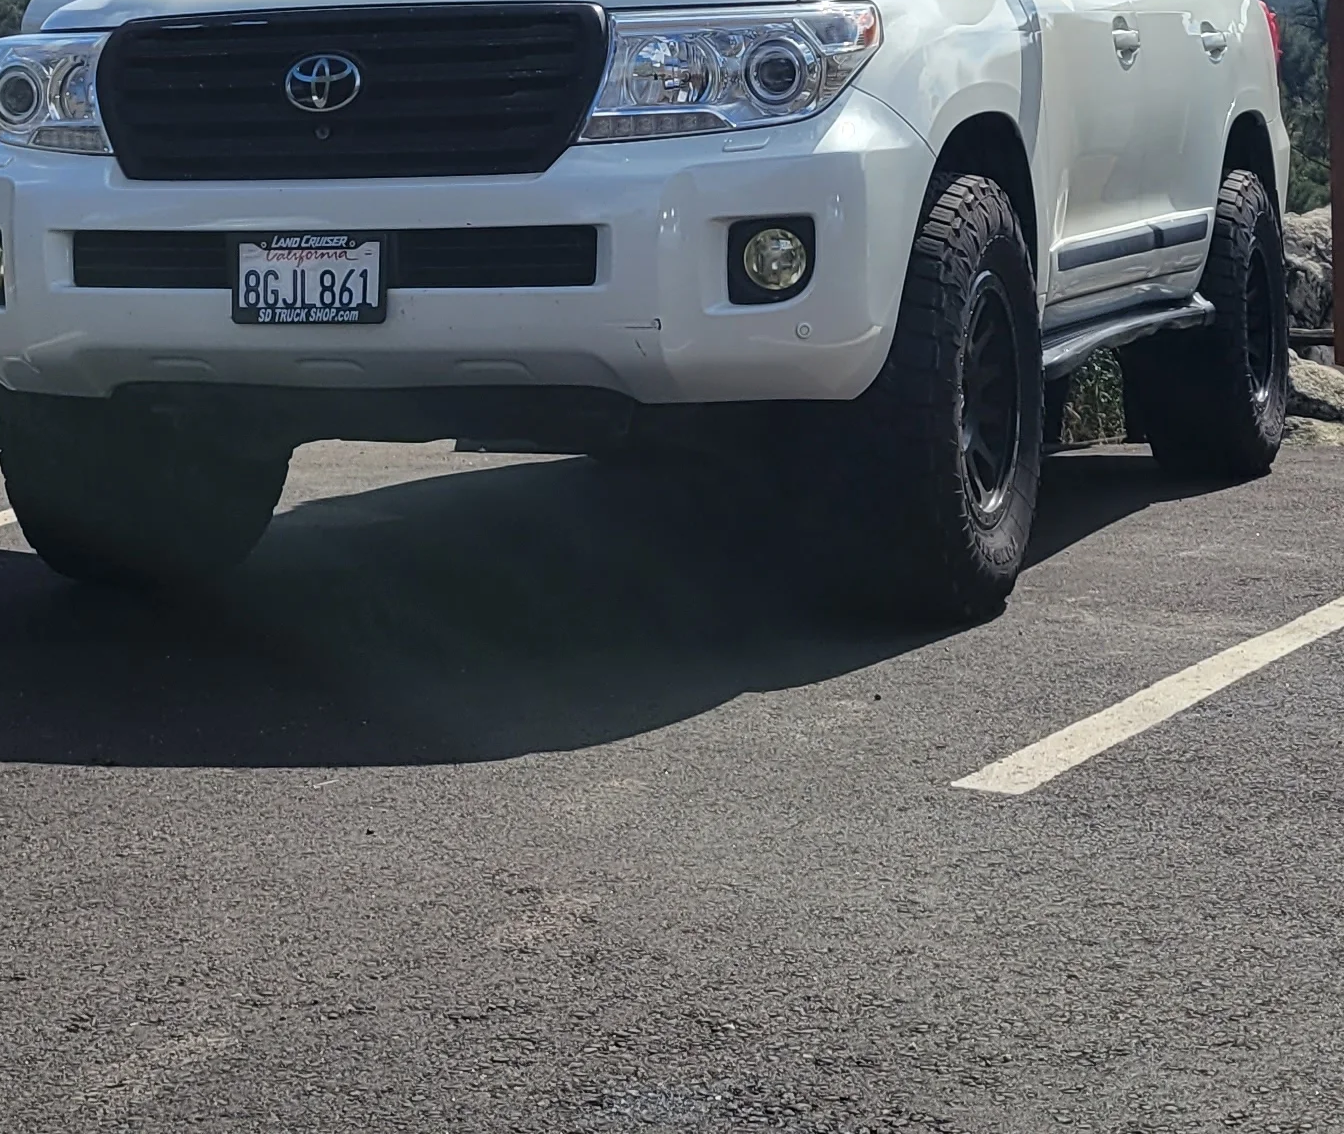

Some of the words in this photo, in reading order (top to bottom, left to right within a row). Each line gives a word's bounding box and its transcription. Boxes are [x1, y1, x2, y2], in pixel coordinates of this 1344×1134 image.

[271, 236, 300, 248] LAND
[301, 235, 348, 247] CRUISER
[266, 249, 359, 268] California
[244, 268, 373, 307] 8GJL861
[258, 309, 273, 323] SD
[273, 308, 307, 322] TRUCK
[309, 308, 359, 322] SHOP.com
